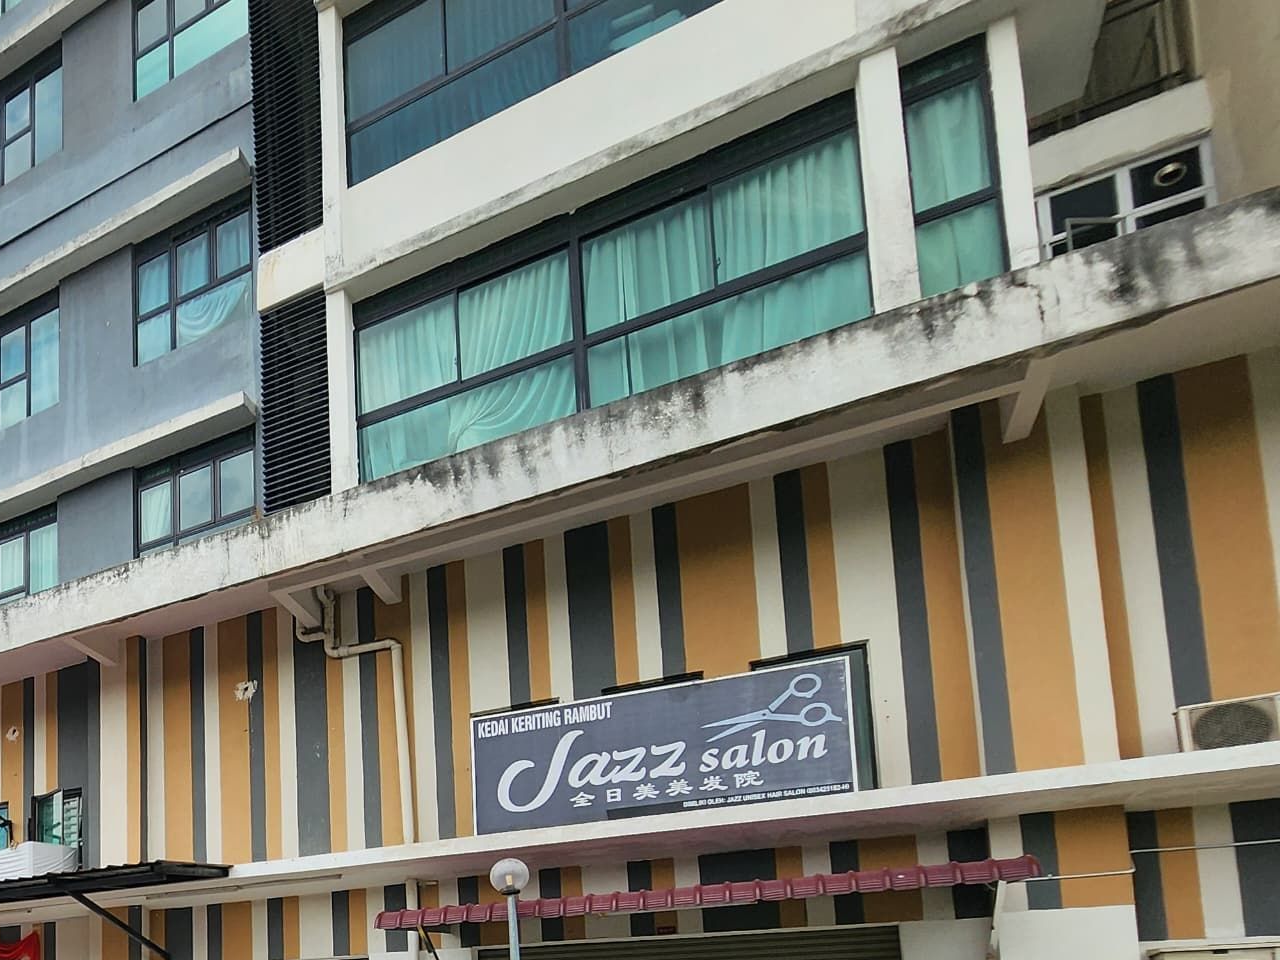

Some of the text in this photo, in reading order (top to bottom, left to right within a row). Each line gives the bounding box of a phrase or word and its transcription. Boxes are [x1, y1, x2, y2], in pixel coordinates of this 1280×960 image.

[477, 702, 613, 739] KEDAI KERITING RAMBUT
[497, 729, 828, 813] Jazz salon
[727, 795, 742, 803] JAZZ
[783, 788, 806, 796] SALON
